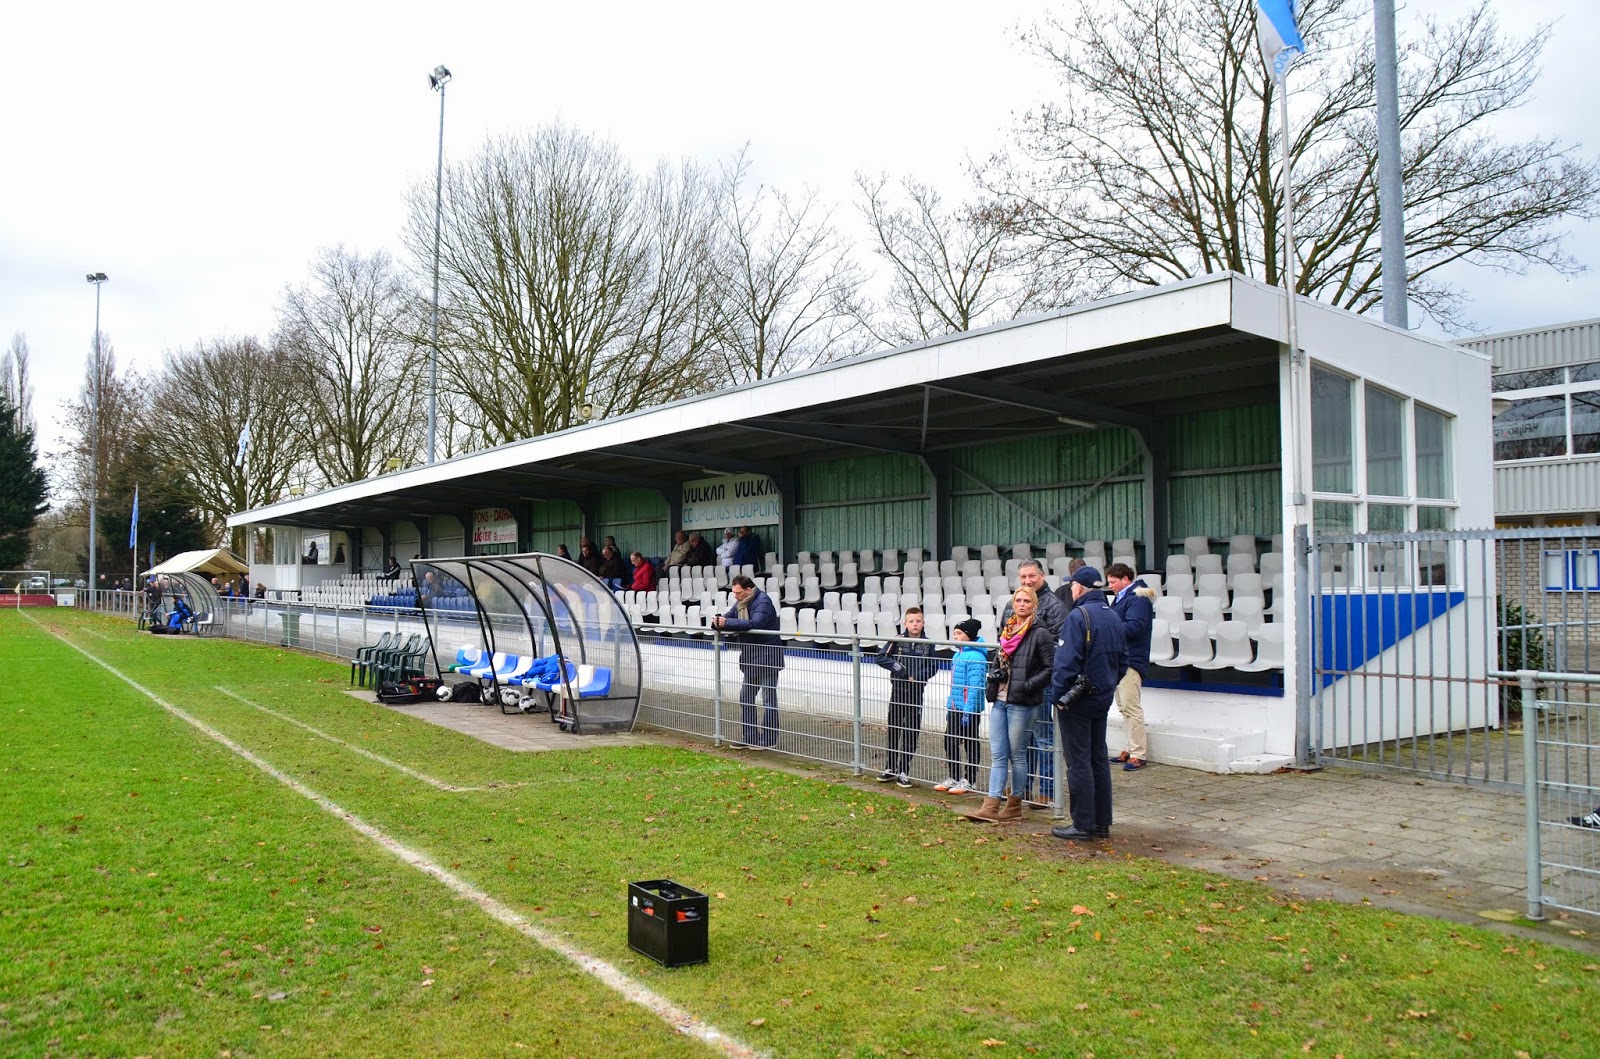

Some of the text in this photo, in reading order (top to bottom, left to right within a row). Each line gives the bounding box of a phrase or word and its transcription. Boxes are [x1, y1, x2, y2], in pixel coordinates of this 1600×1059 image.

[684, 479, 777, 504] VULKAN VULKA
[683, 504, 730, 523] COUPLINGS
